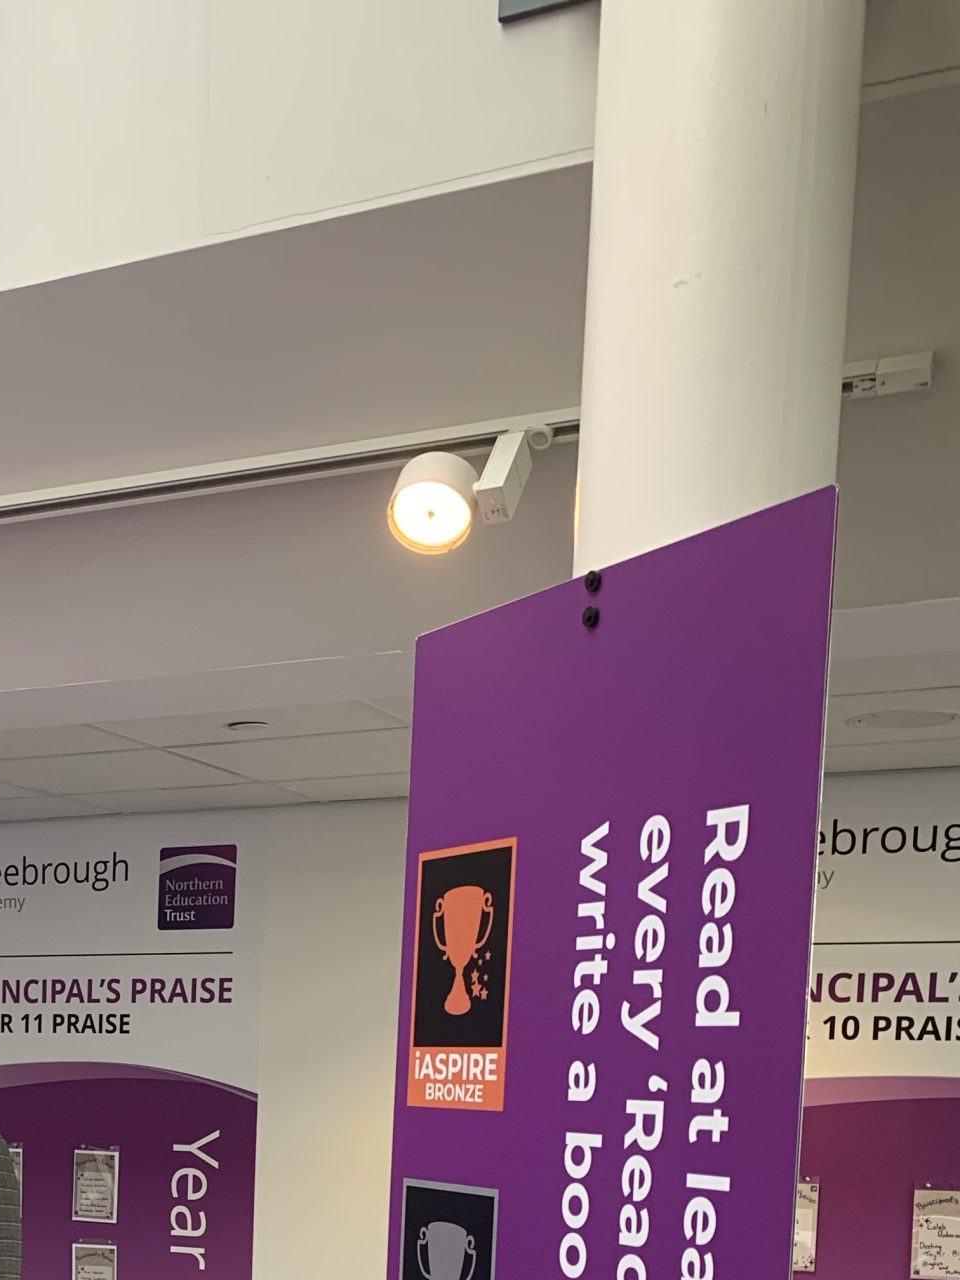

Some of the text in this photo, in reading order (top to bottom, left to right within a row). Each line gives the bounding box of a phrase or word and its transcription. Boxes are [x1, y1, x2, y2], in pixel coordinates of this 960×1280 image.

[165, 878, 224, 891] Northern
[164, 893, 229, 907] Education
[163, 909, 196, 922] Trust
[572, 820, 615, 1035] write
[695, 804, 750, 1027] Read
[621, 814, 671, 1051] every
[130, 977, 233, 1003] PRAISE
[20, 1013, 44, 1034] 11
[52, 1013, 131, 1034] PRAISE
[823, 1015, 861, 1041] 10
[872, 1015, 960, 1041] PRAI
[414, 1050, 498, 1082] iASPIRE
[425, 1083, 483, 1103] BRONZE
[568, 1060, 597, 1102] a
[689, 1058, 730, 1144] at
[169, 1129, 221, 1271] Year
